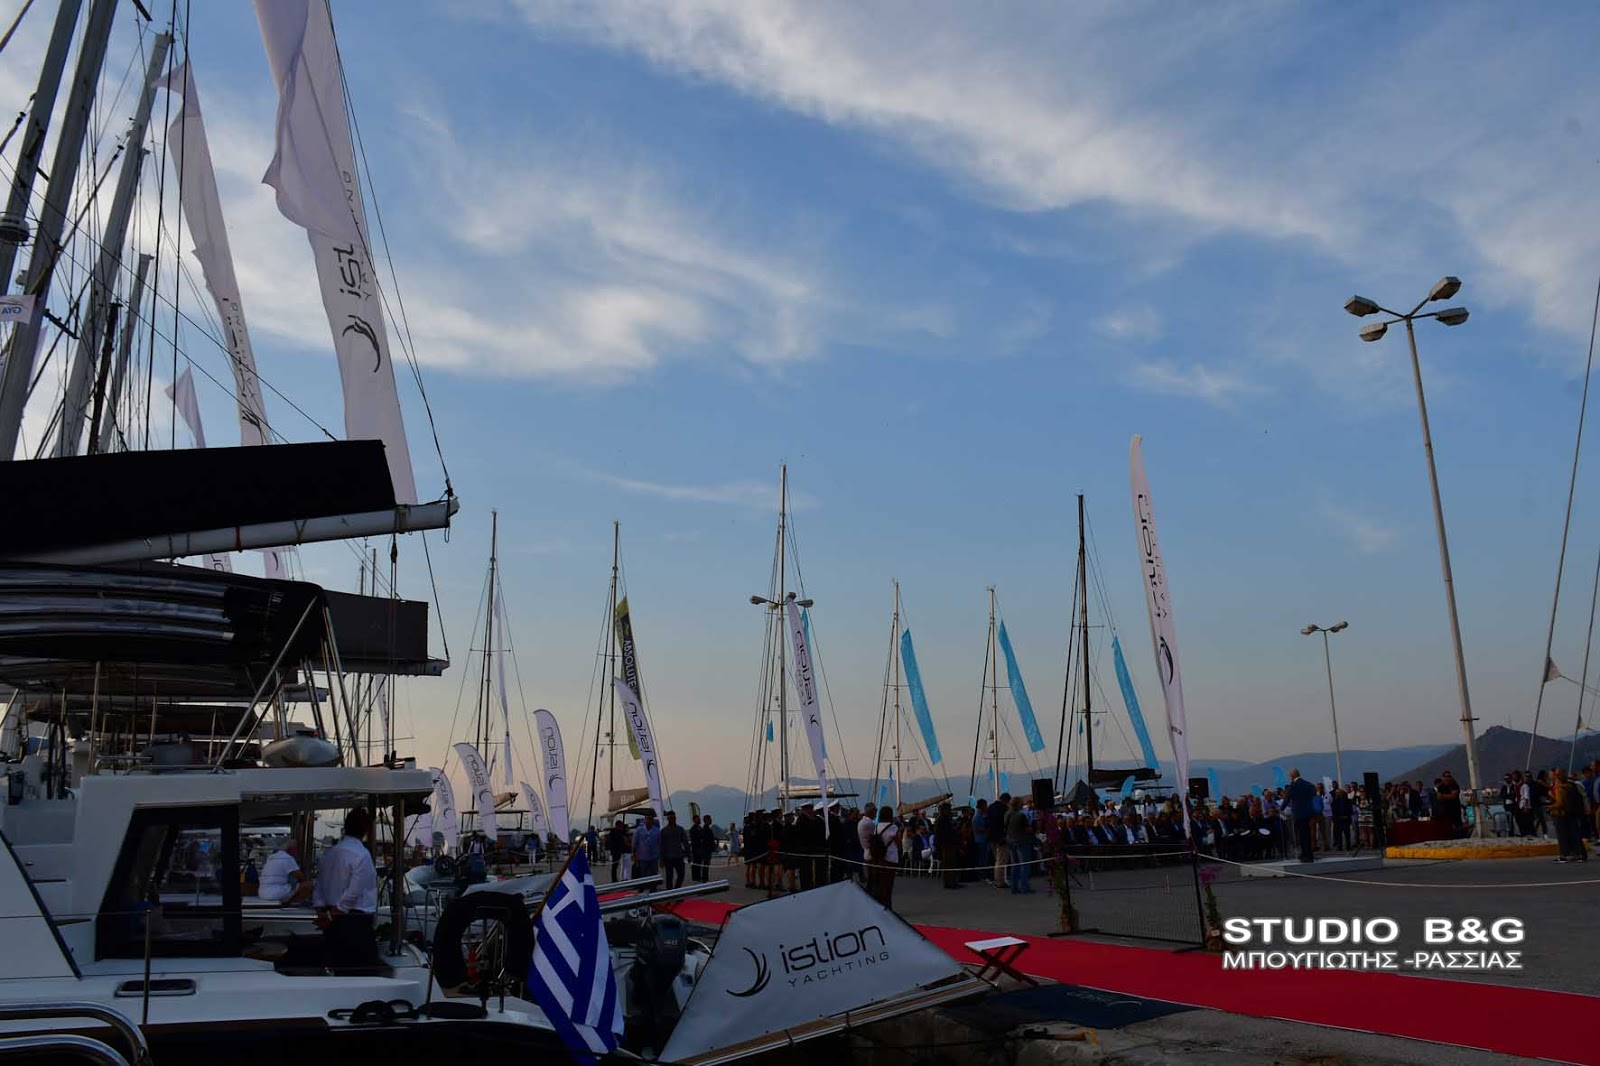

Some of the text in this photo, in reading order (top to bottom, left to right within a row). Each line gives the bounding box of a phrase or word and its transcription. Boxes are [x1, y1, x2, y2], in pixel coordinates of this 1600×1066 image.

[624, 640, 637, 690] ABSOLUTE
[779, 925, 886, 974] istion
[788, 951, 890, 988] YACHTING
